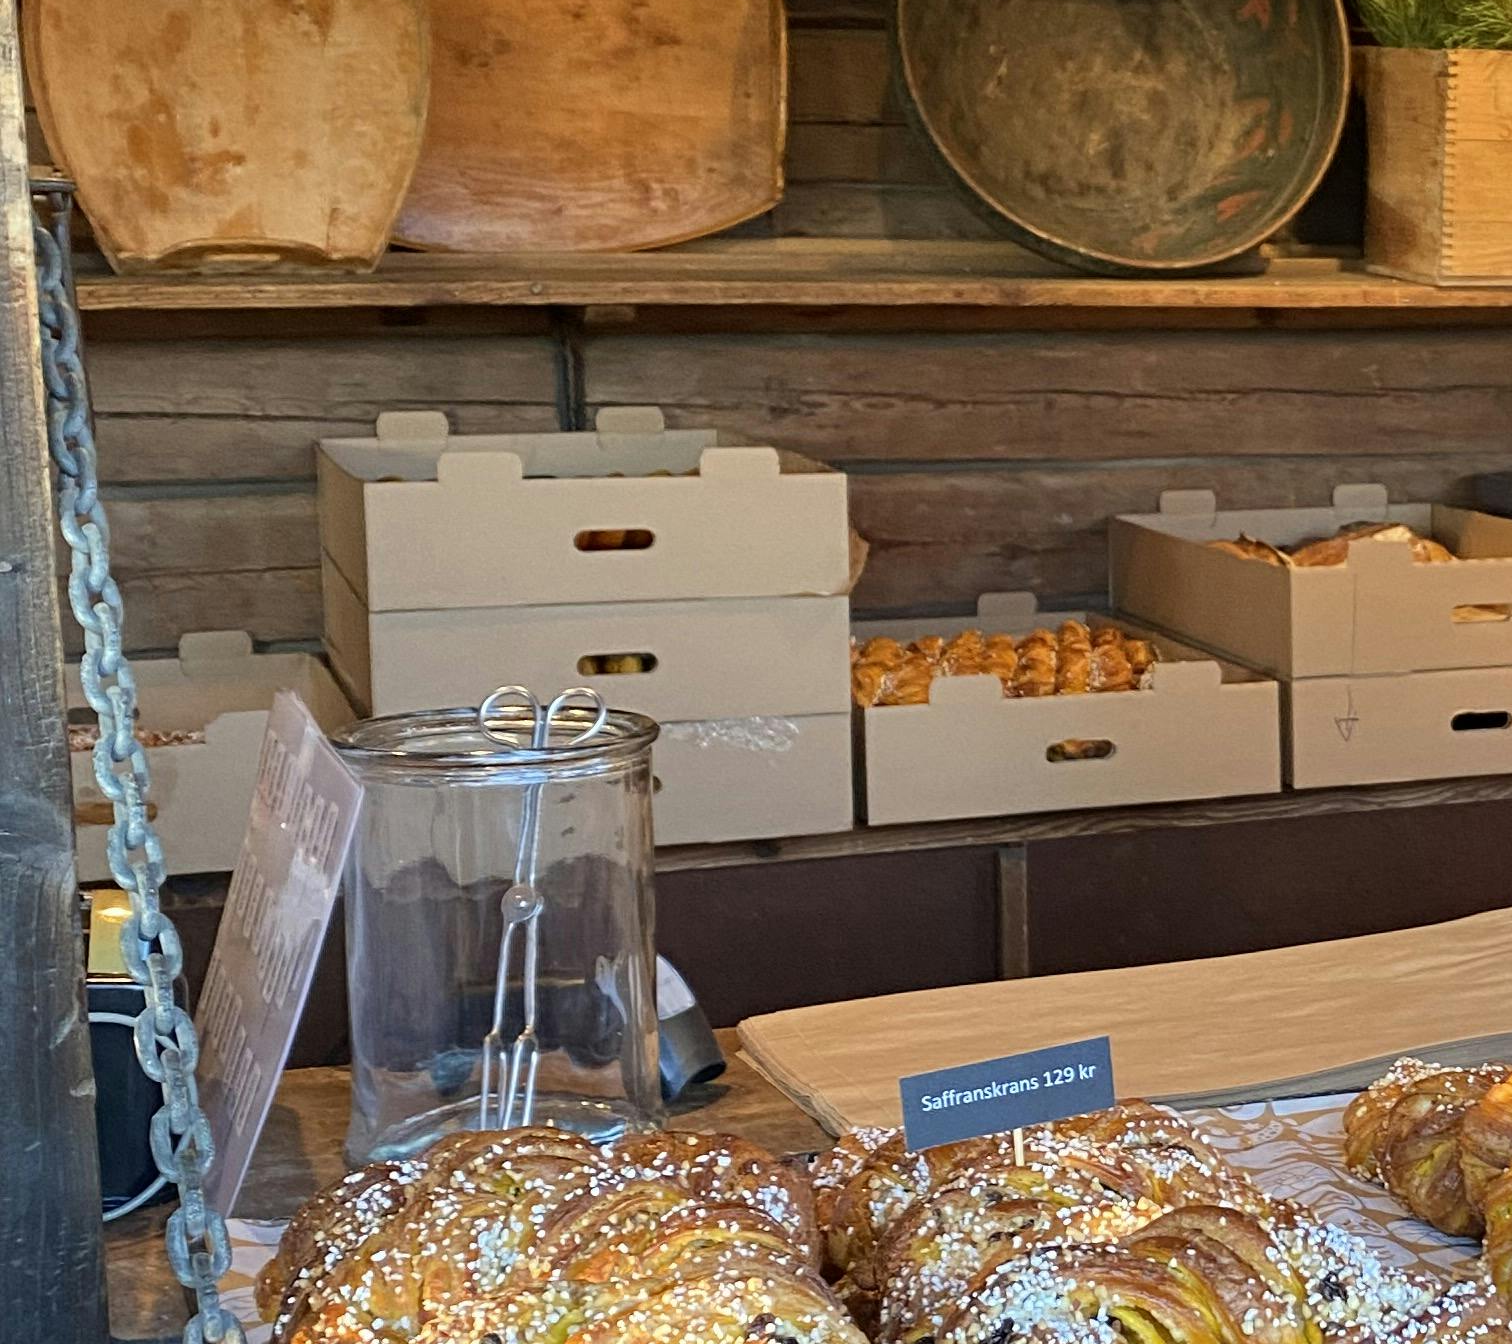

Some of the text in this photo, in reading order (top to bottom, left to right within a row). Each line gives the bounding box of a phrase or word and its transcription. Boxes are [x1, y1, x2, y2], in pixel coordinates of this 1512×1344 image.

[920, 1063, 1097, 1112] Saffranskrans 129 kr
